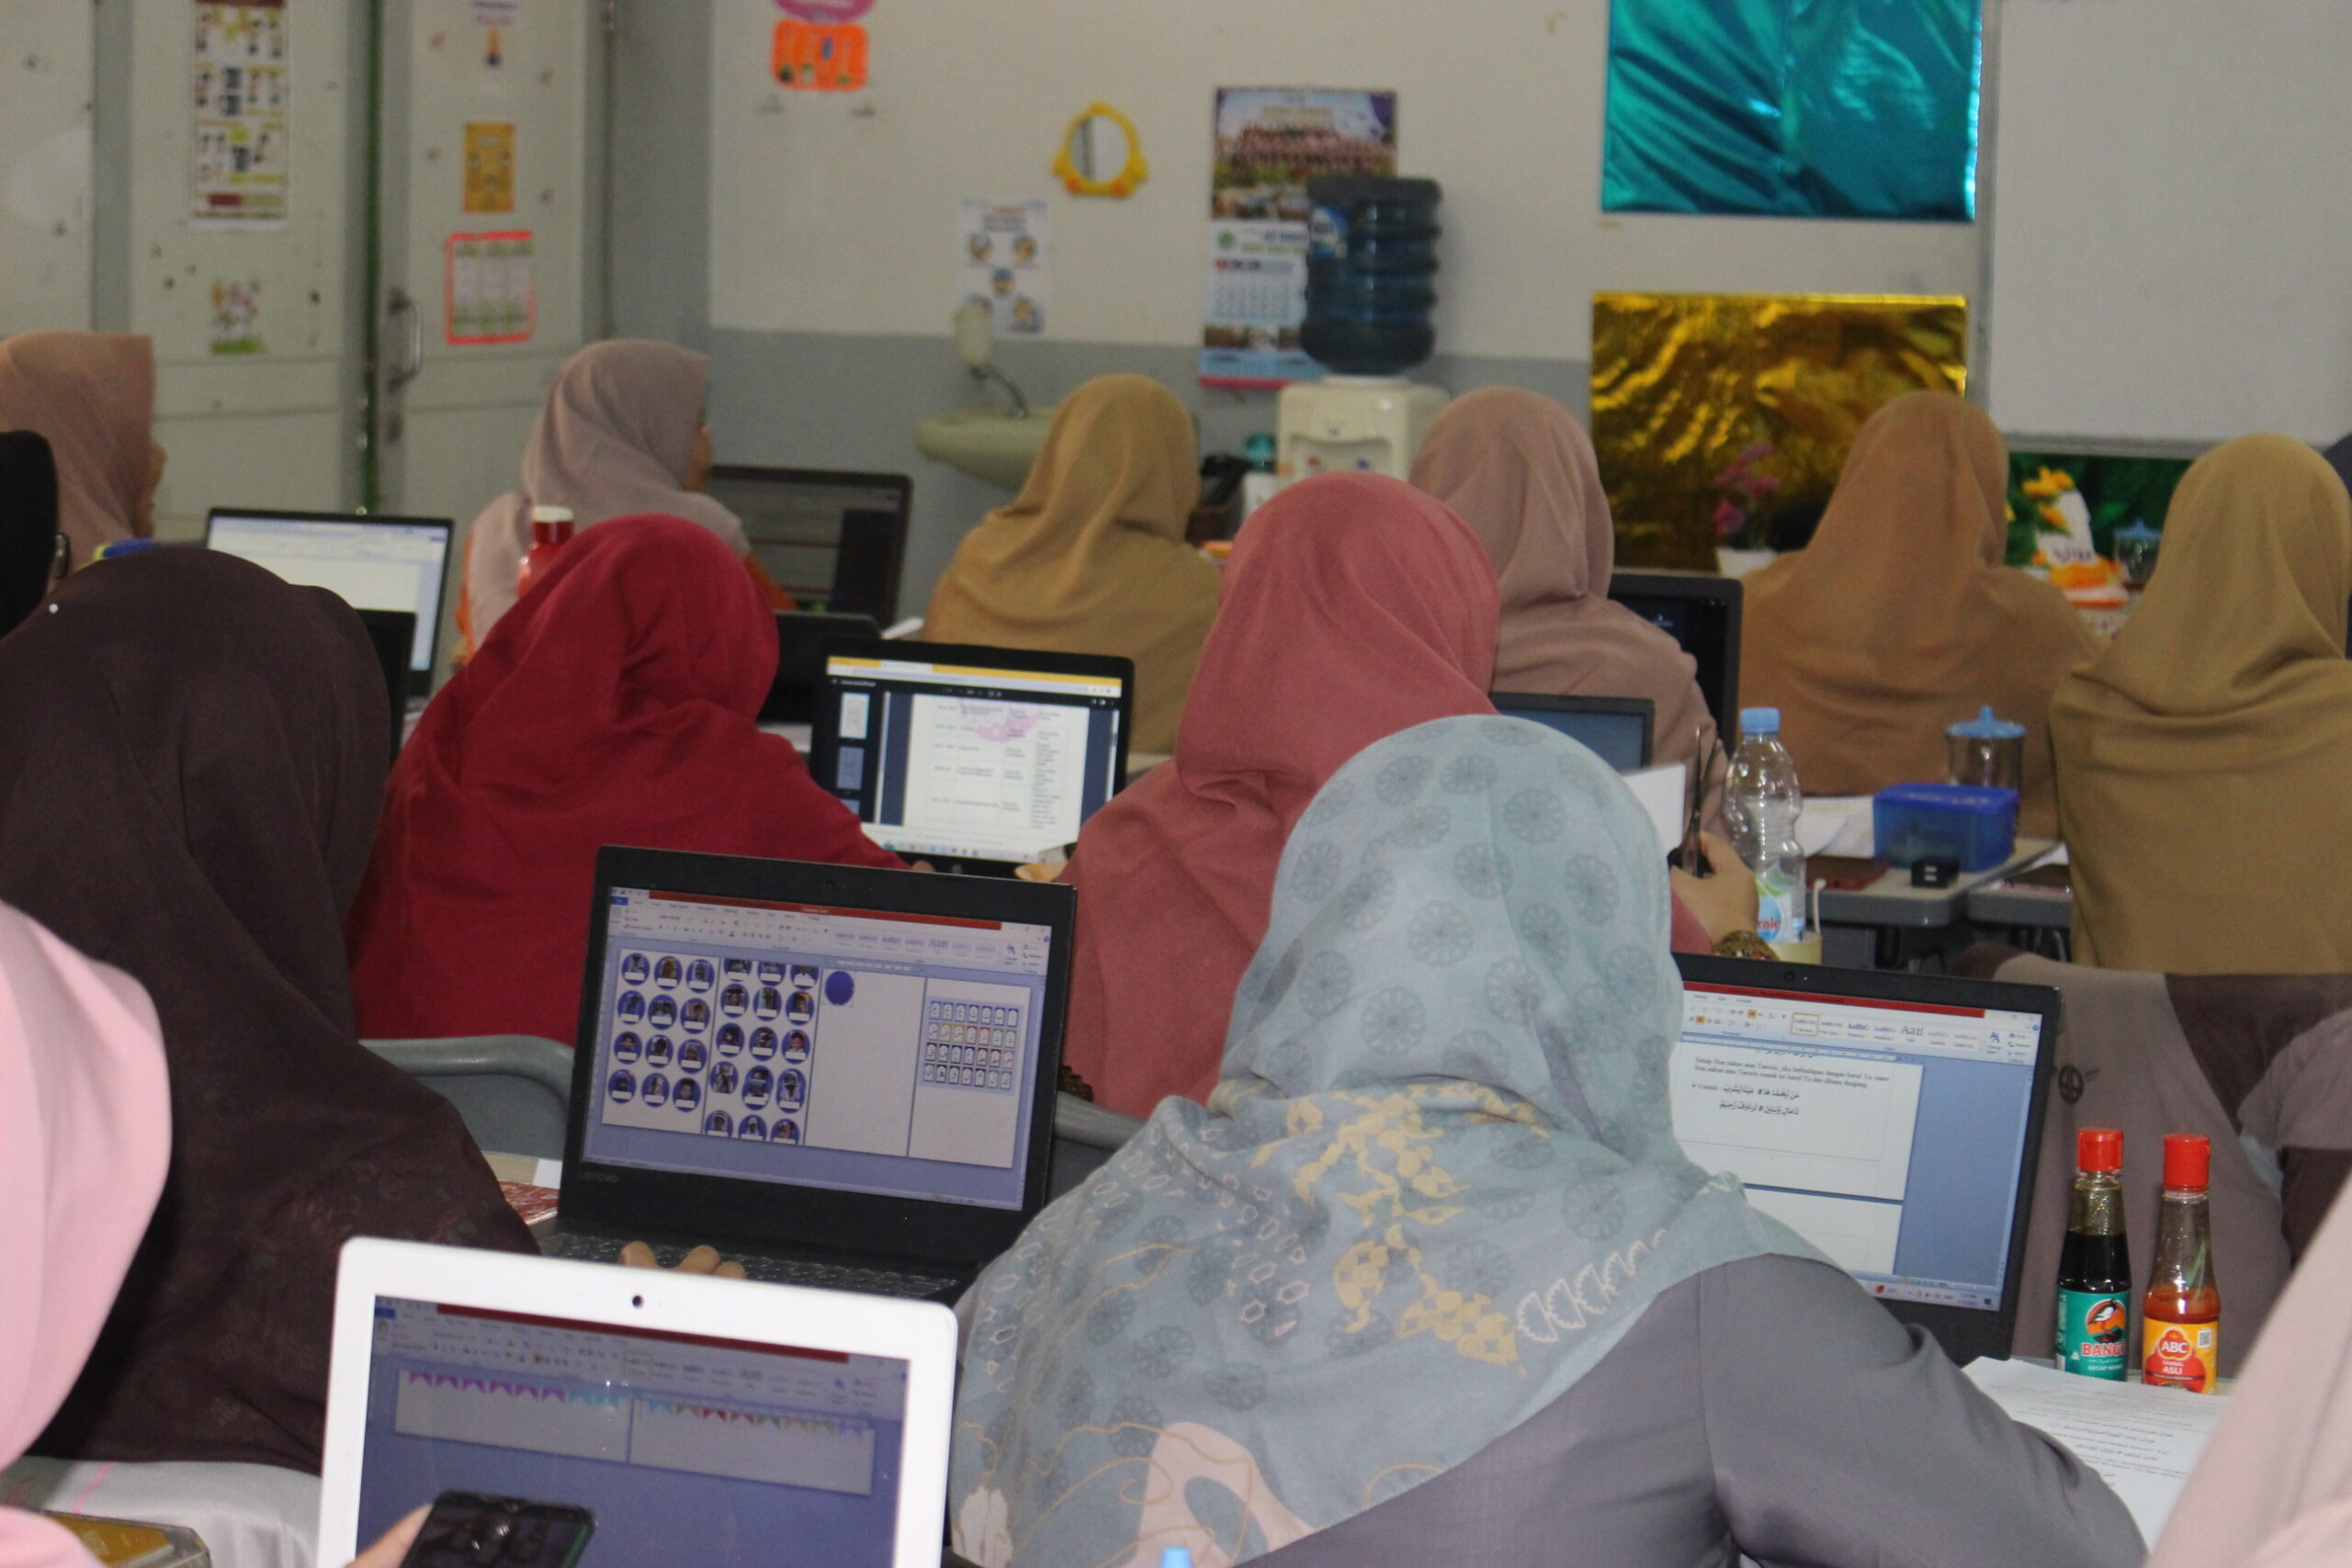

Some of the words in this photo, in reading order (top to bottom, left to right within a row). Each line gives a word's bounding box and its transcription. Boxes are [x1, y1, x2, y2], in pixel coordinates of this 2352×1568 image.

[1758, 917, 1781, 930] rale
[2161, 1340, 2189, 1353] ABC
[2163, 1366, 2183, 1375] ASLI
